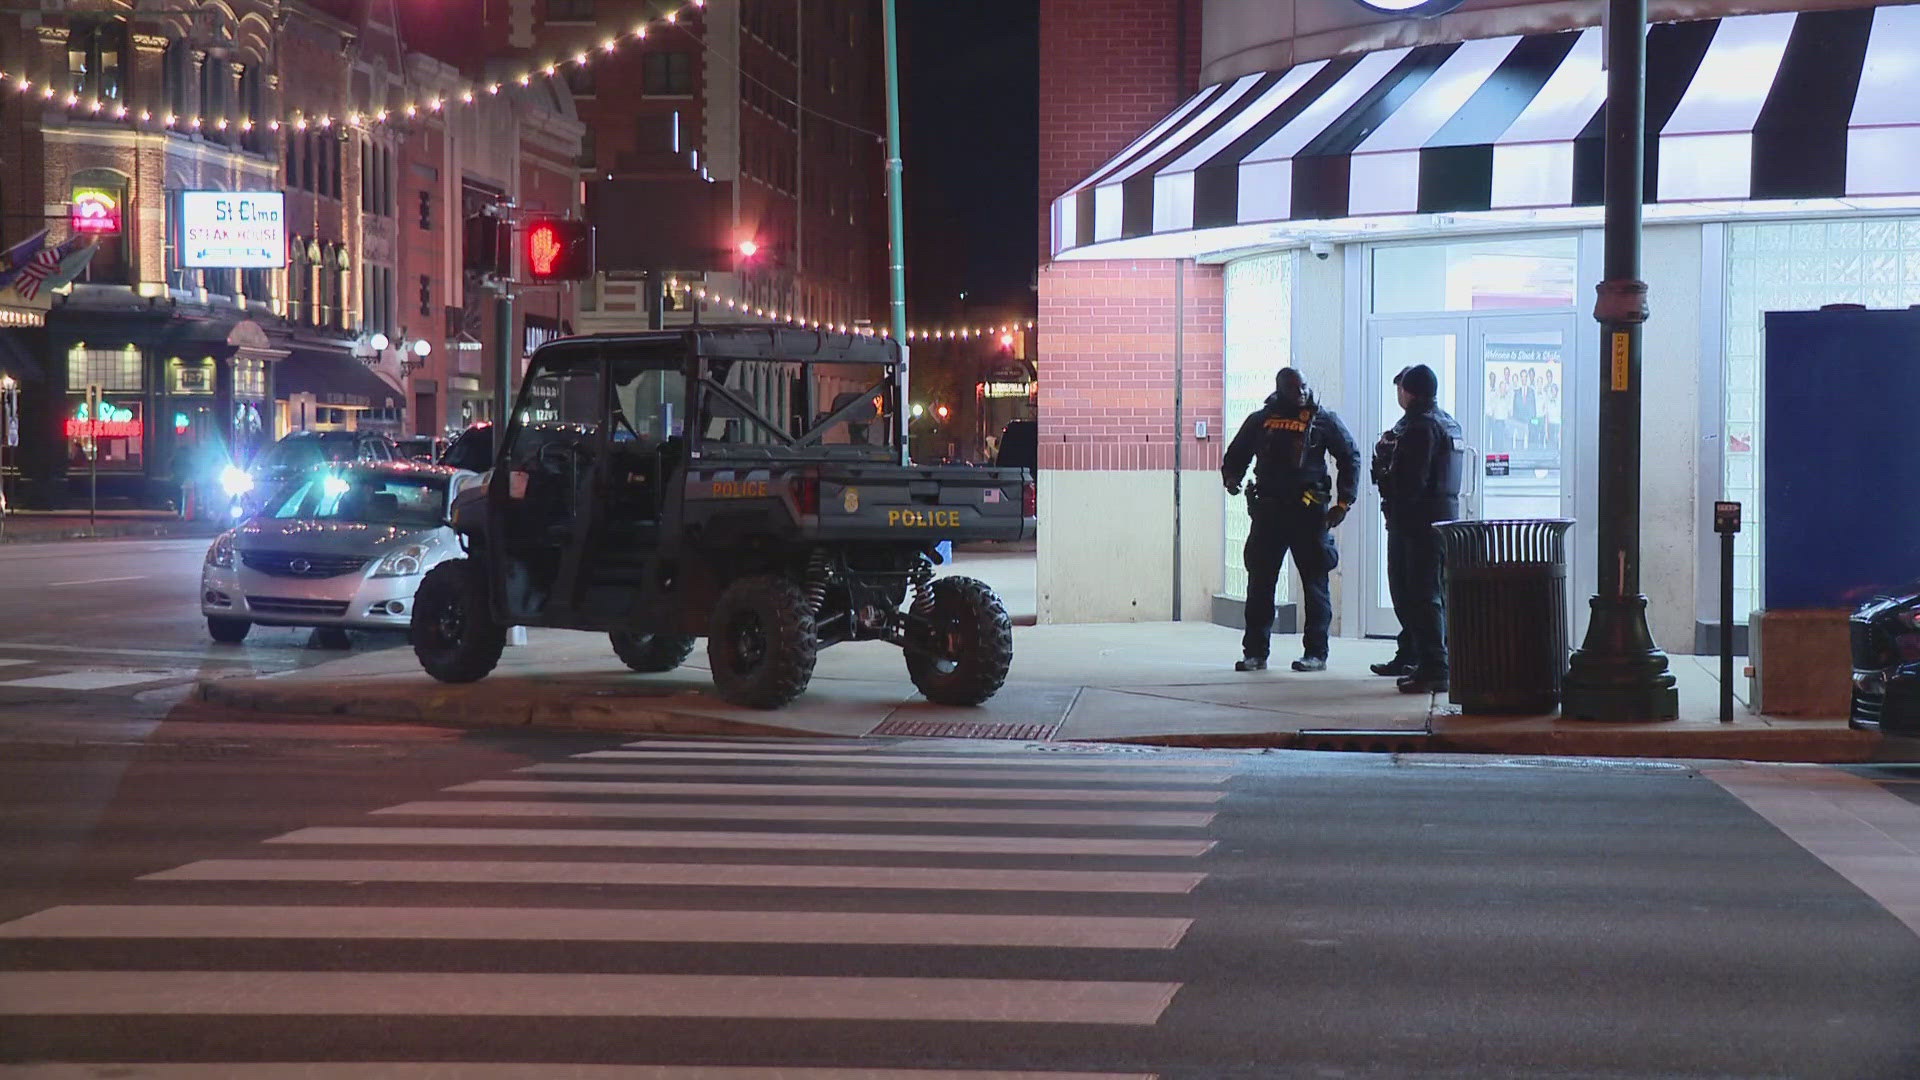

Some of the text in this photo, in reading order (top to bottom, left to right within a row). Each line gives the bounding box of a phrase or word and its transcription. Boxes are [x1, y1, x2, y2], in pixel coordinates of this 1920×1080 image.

[216, 200, 278, 221] St Elmo
[183, 372, 203, 384] 127
[712, 481, 768, 497] POLICE
[888, 510, 960, 527] POLICE
